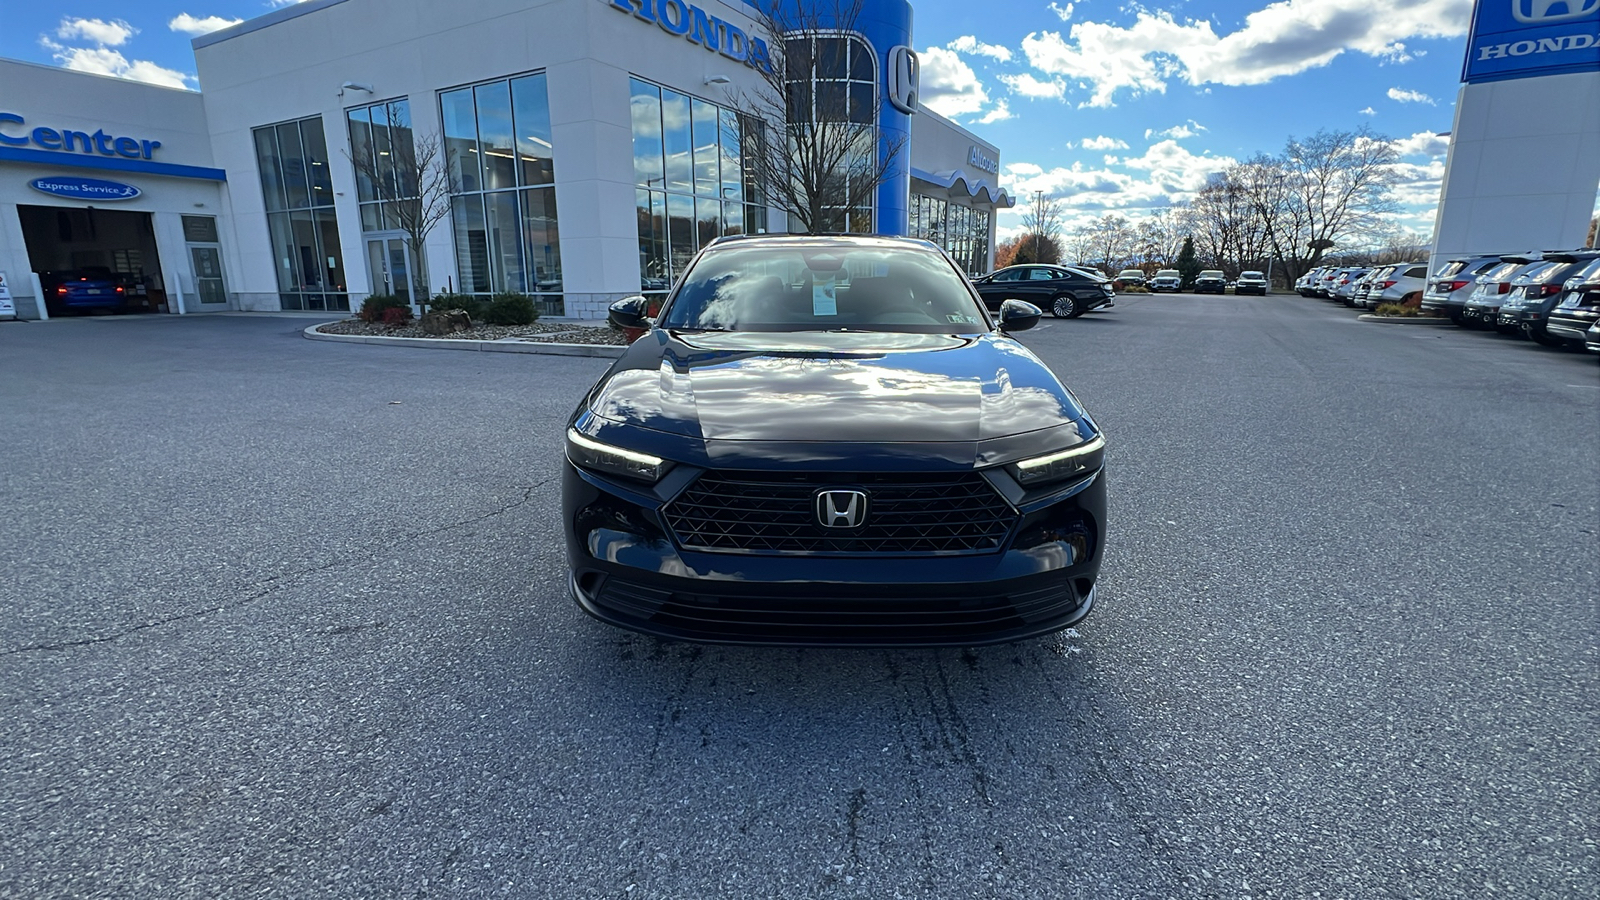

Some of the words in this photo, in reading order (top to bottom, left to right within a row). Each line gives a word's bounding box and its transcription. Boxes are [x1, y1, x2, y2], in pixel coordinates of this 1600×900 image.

[0, 112, 162, 160] Center
[37, 180, 79, 192] Express
[81, 184, 120, 194] Service
